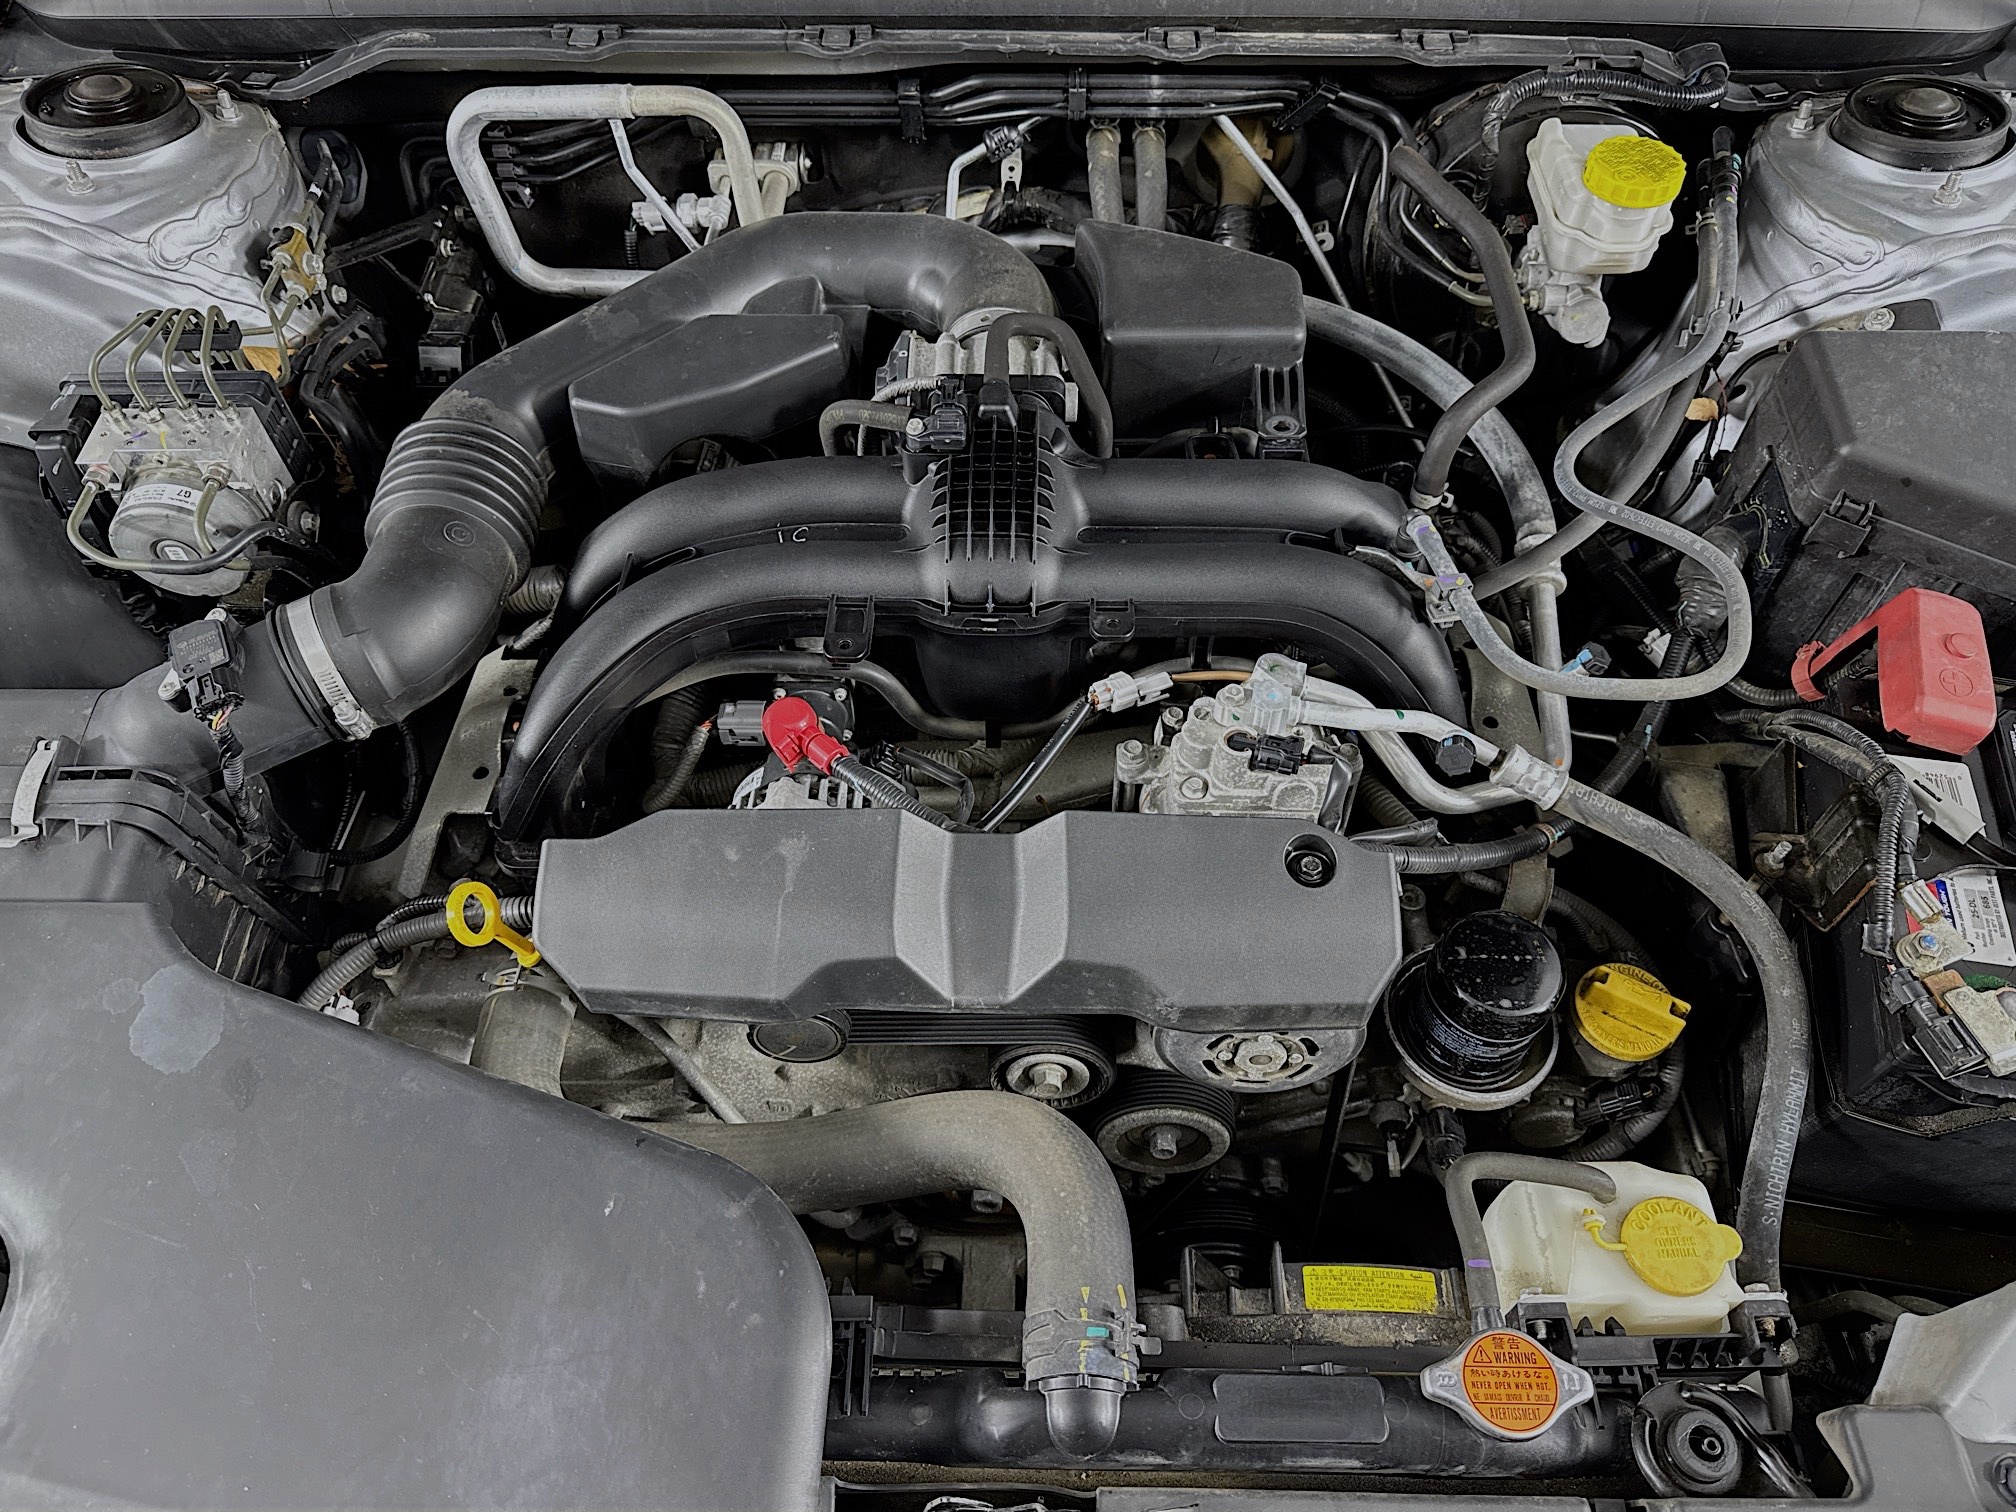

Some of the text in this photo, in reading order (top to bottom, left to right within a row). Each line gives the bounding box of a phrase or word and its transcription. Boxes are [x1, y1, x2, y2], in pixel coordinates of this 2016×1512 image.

[177, 489, 192, 499] G7
[1980, 896, 1991, 909] 685
[1632, 1202, 1709, 1231] COOLANT
[1340, 1269, 1367, 1277] CAUTION
[1372, 1270, 1404, 1278] ATTENTION
[1492, 1336, 1521, 1350] 警告
[1493, 1351, 1537, 1365] WARNING
[1471, 1381, 1551, 1391] NEVER OPEN WHEN HOT.
[1490, 1407, 1541, 1421] AVERTISSMENT
